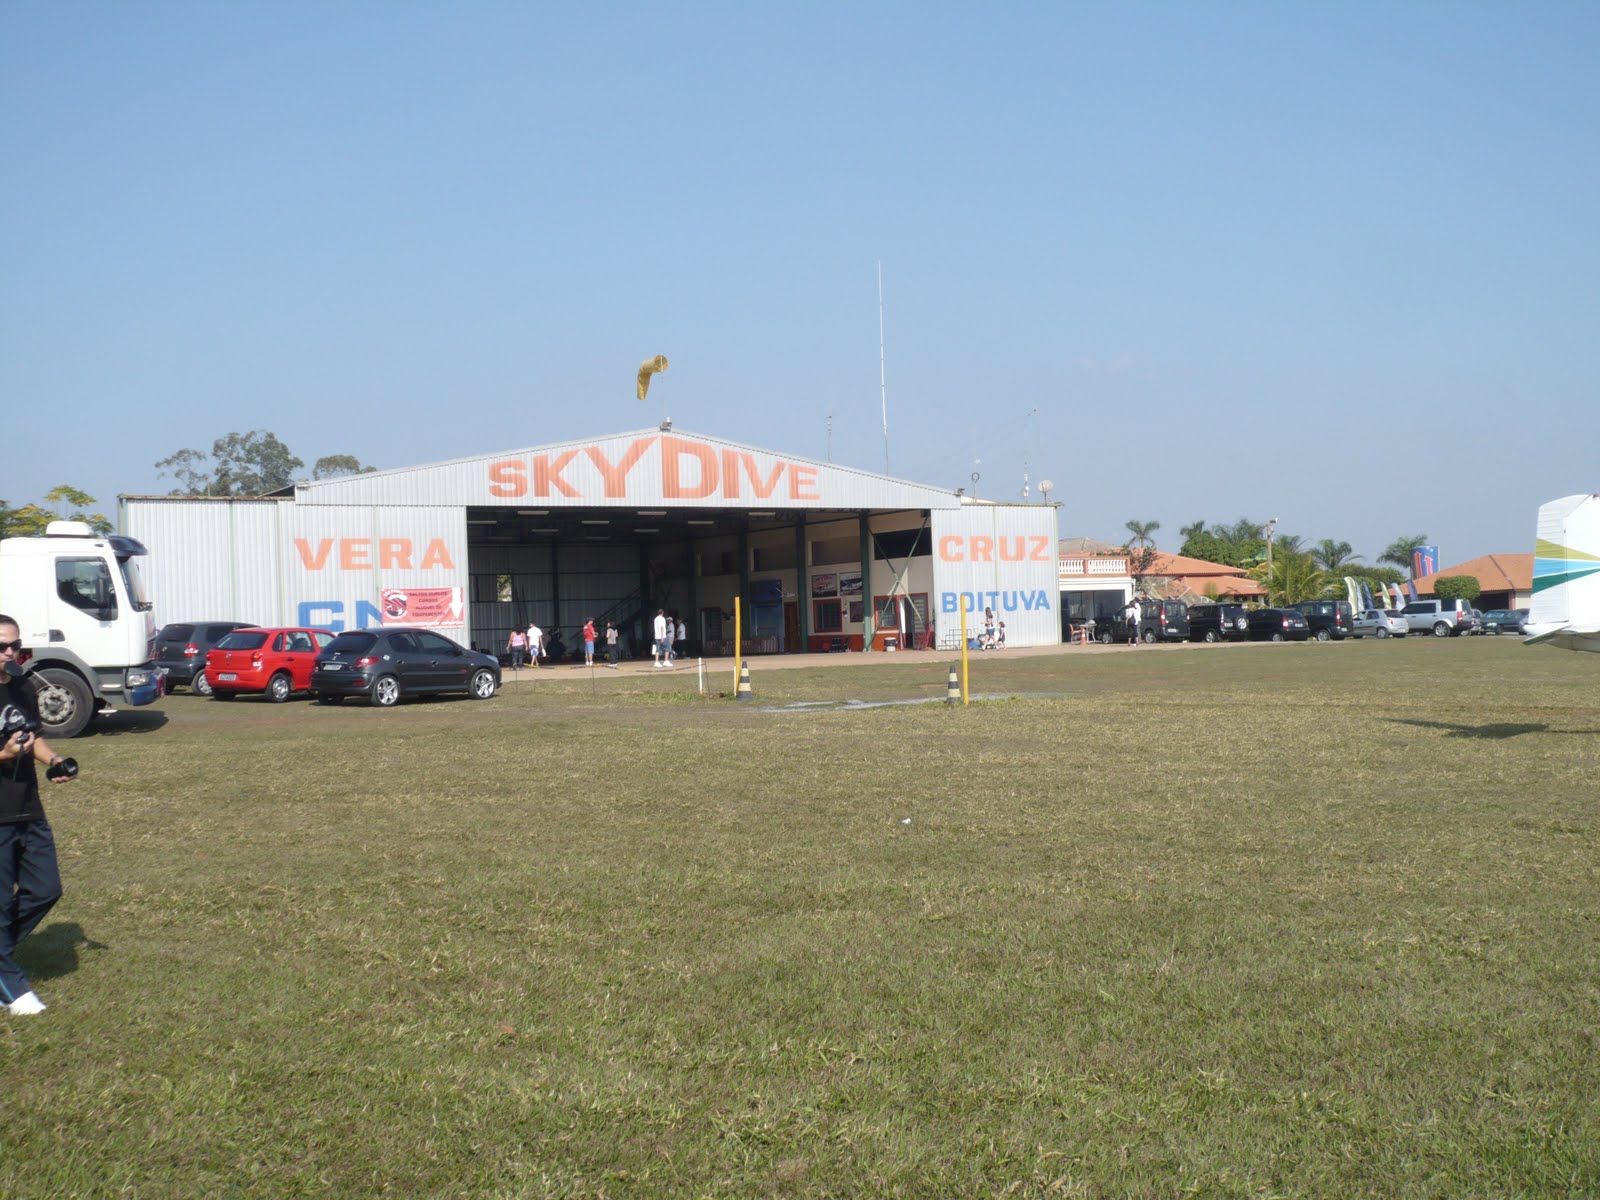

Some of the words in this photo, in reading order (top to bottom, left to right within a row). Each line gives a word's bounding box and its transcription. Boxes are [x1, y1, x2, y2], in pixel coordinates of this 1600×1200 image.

[488, 435, 820, 500] SKYDIVE
[293, 537, 456, 570] VERA
[938, 535, 1051, 562] CRUZ
[941, 590, 1051, 613] BOITUVA
